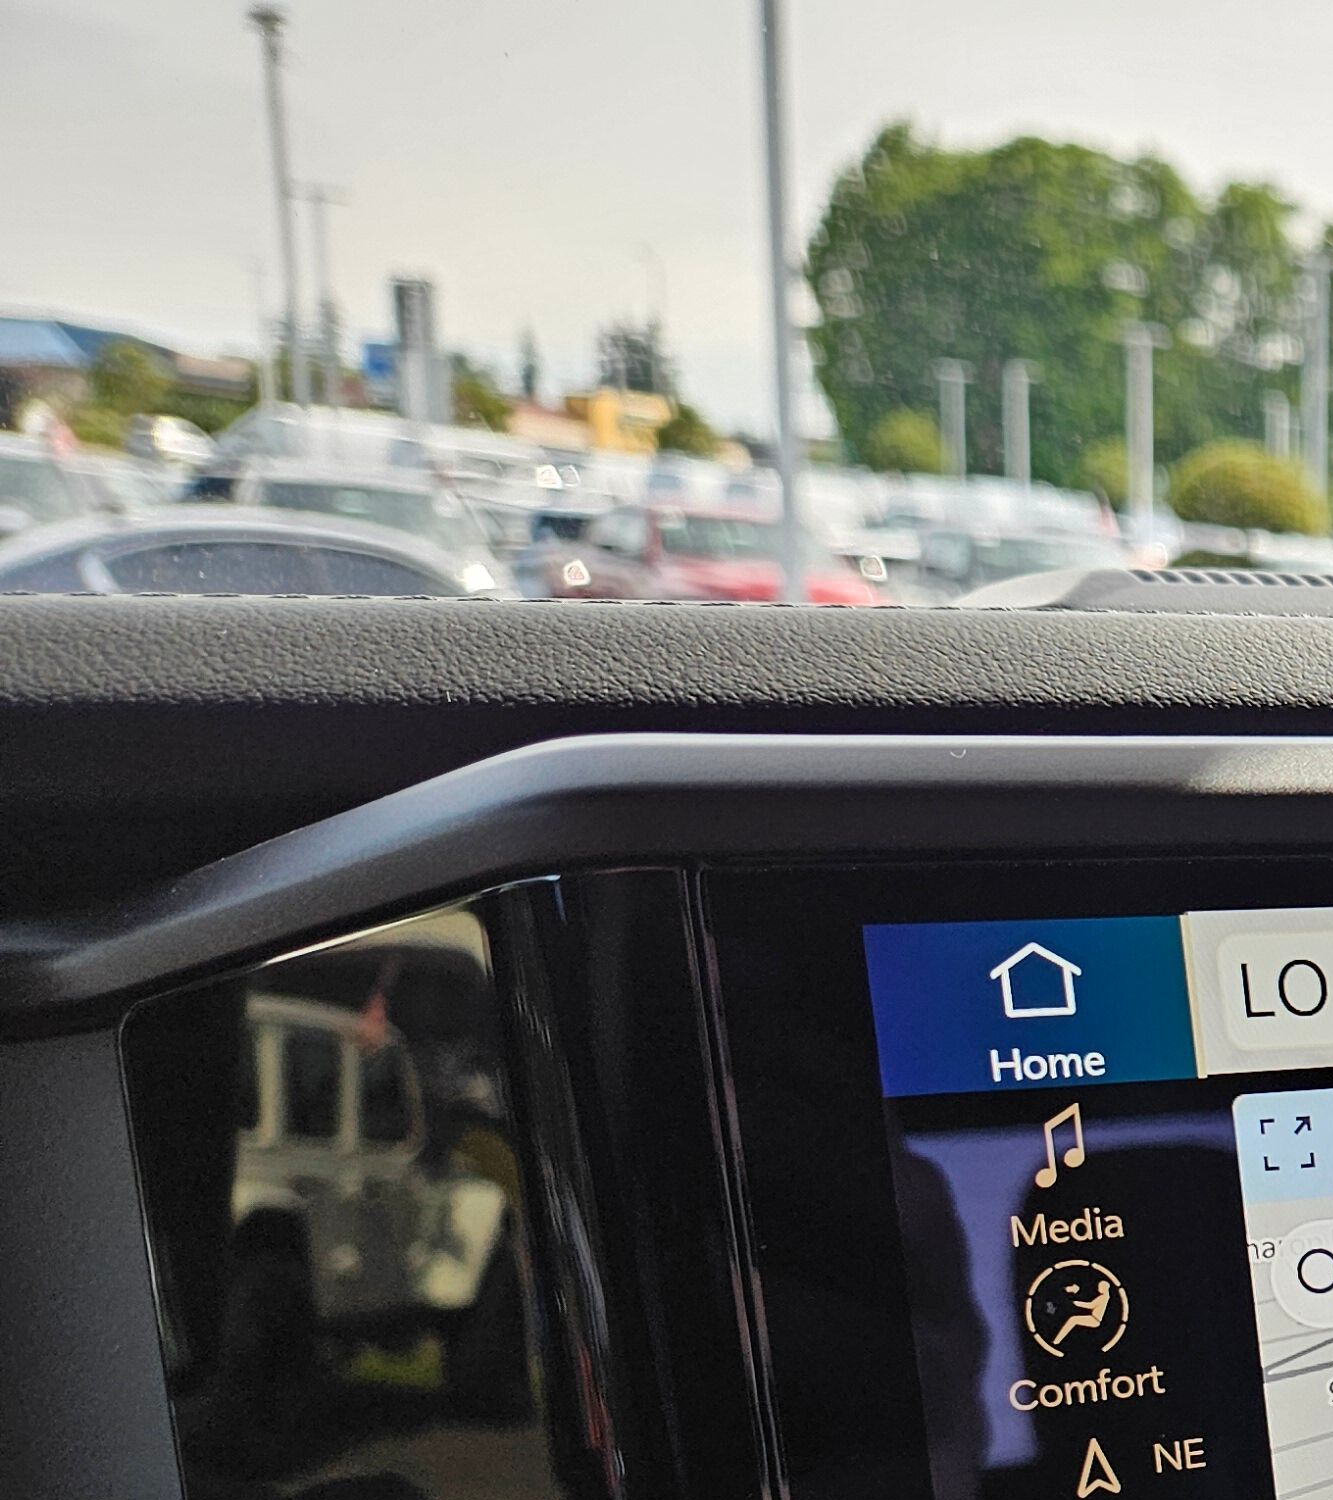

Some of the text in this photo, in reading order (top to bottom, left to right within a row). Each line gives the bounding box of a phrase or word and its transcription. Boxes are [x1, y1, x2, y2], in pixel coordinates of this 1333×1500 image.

[1241, 959, 1327, 1017] LO
[991, 1048, 1106, 1082] Home
[1011, 1208, 1124, 1248] Media
[1010, 1366, 1165, 1411] Comfort
[1154, 1440, 1206, 1472] NE
